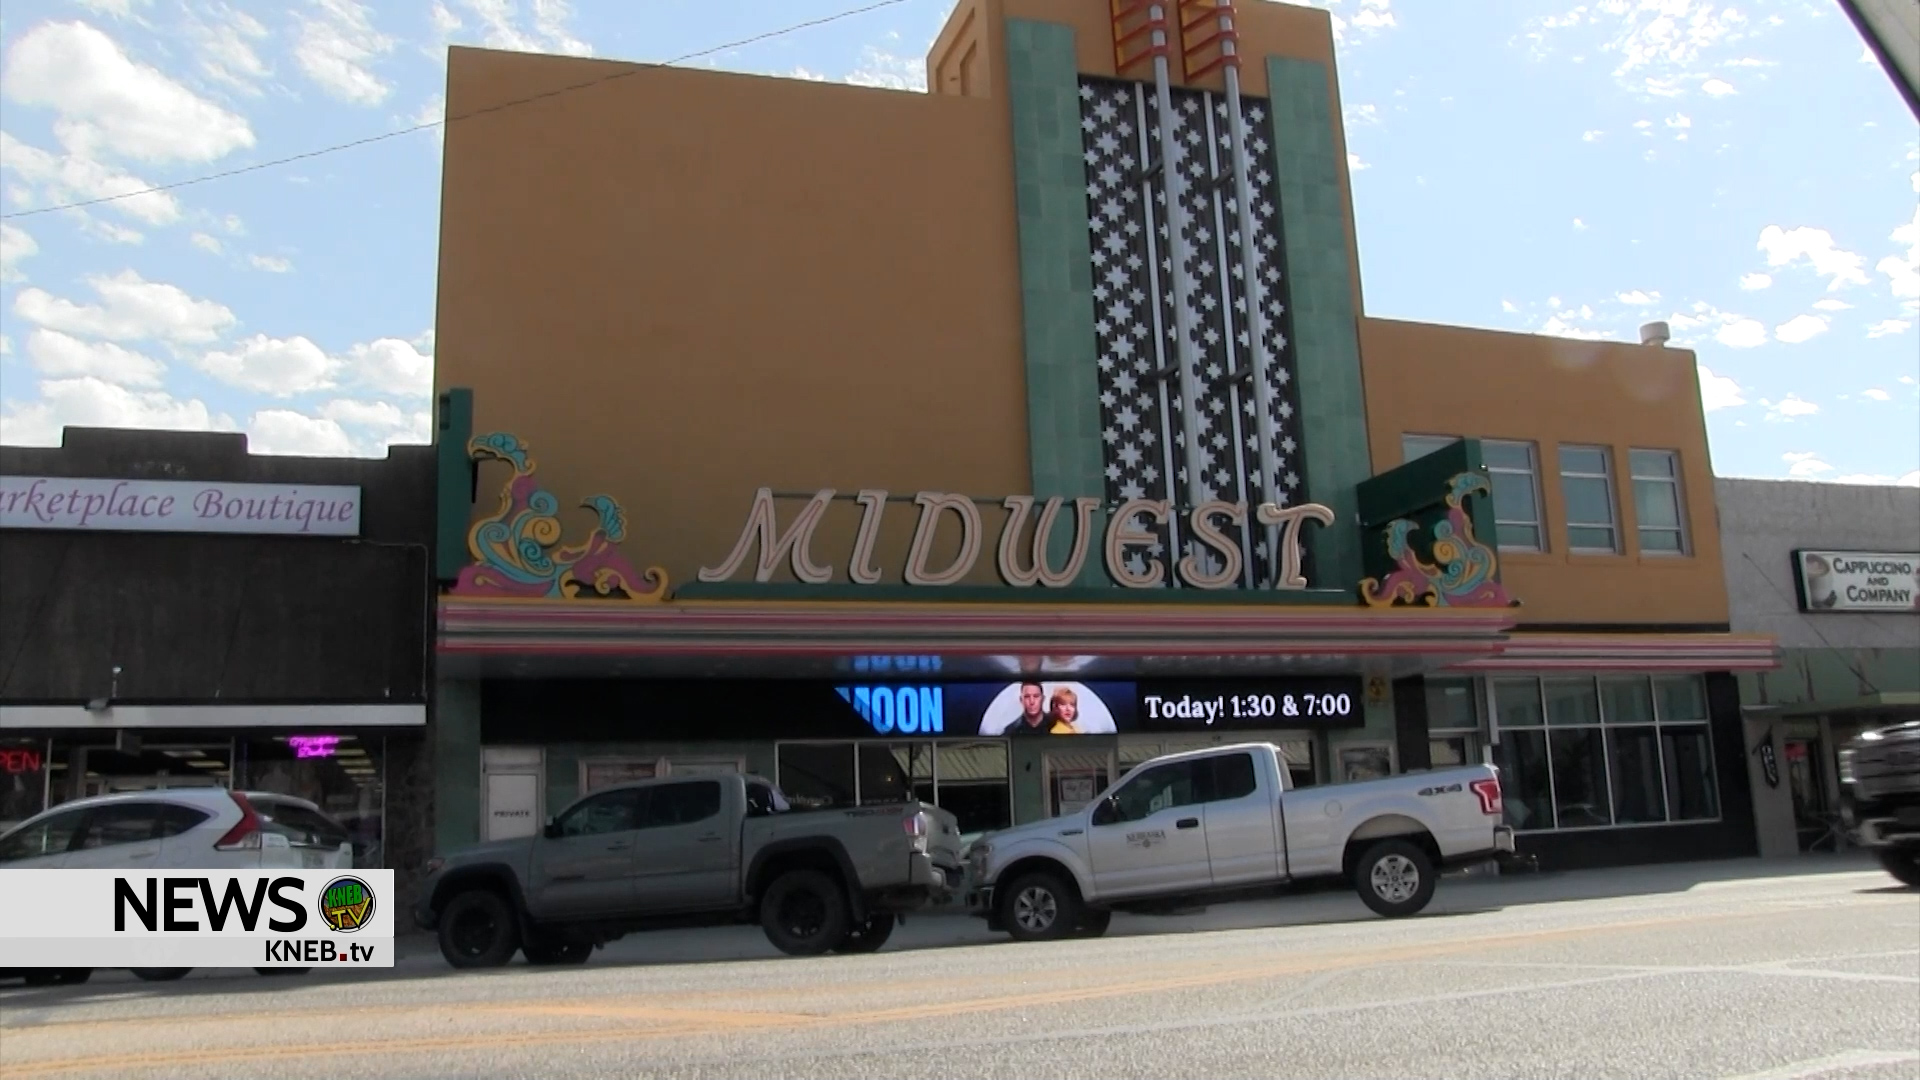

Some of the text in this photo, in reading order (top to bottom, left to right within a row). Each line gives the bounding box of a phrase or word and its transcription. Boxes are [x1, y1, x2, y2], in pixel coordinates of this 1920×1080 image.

[193, 488, 355, 533] Boutique
[697, 486, 1336, 591] MIDWEST
[1832, 557, 1912, 575] CAPPUCCINO
[1846, 585, 1911, 602] COMPANY
[1866, 577, 1890, 586] AND
[1144, 693, 1351, 725] Today! 1:30 & 7:00
